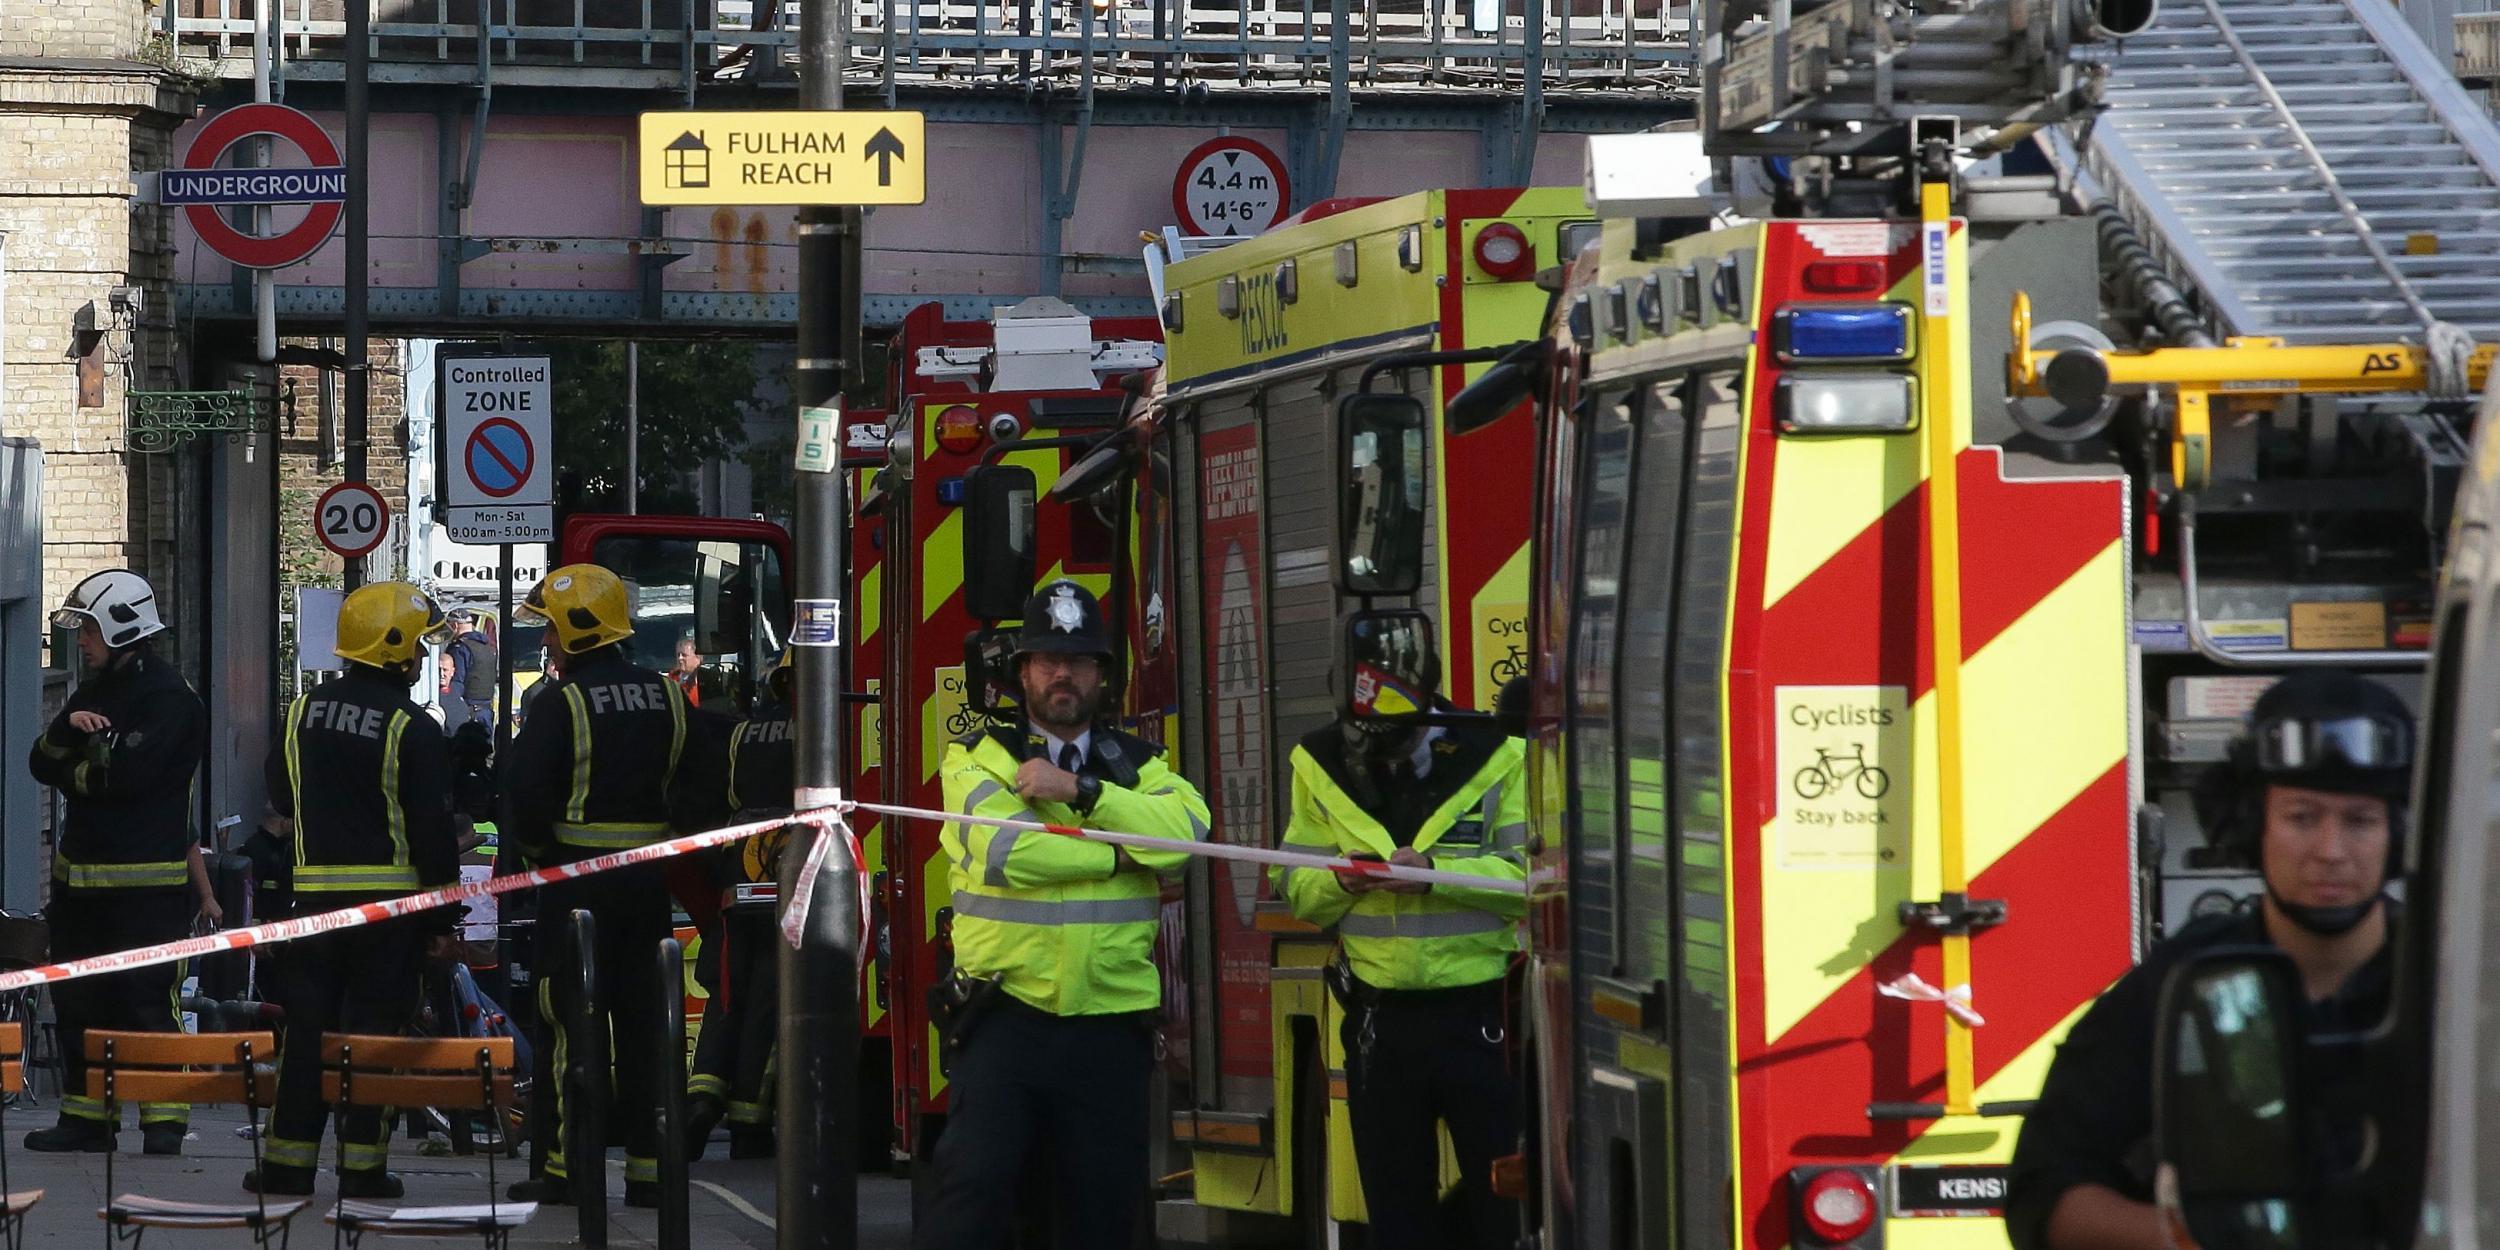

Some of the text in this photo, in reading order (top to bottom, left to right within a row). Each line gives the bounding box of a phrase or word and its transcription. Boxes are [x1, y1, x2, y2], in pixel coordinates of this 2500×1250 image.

[728, 131, 845, 154] FULHAM
[742, 162, 832, 184] REACH
[1197, 166, 1268, 190] 4.4 m
[451, 366, 545, 384] Controlled
[465, 391, 532, 412] ZONE
[325, 503, 377, 535] 20
[474, 511, 498, 522] Mon
[506, 511, 526, 522] Sat
[451, 527, 478, 538] 9.00
[480, 528, 497, 538] am
[504, 526, 531, 537] 5.00
[533, 528, 550, 538] pm
[588, 683, 666, 714] FIRE
[306, 700, 384, 740] FIRE
[1790, 703, 1894, 732] Cyclists
[1795, 808, 1889, 827] Stay back
